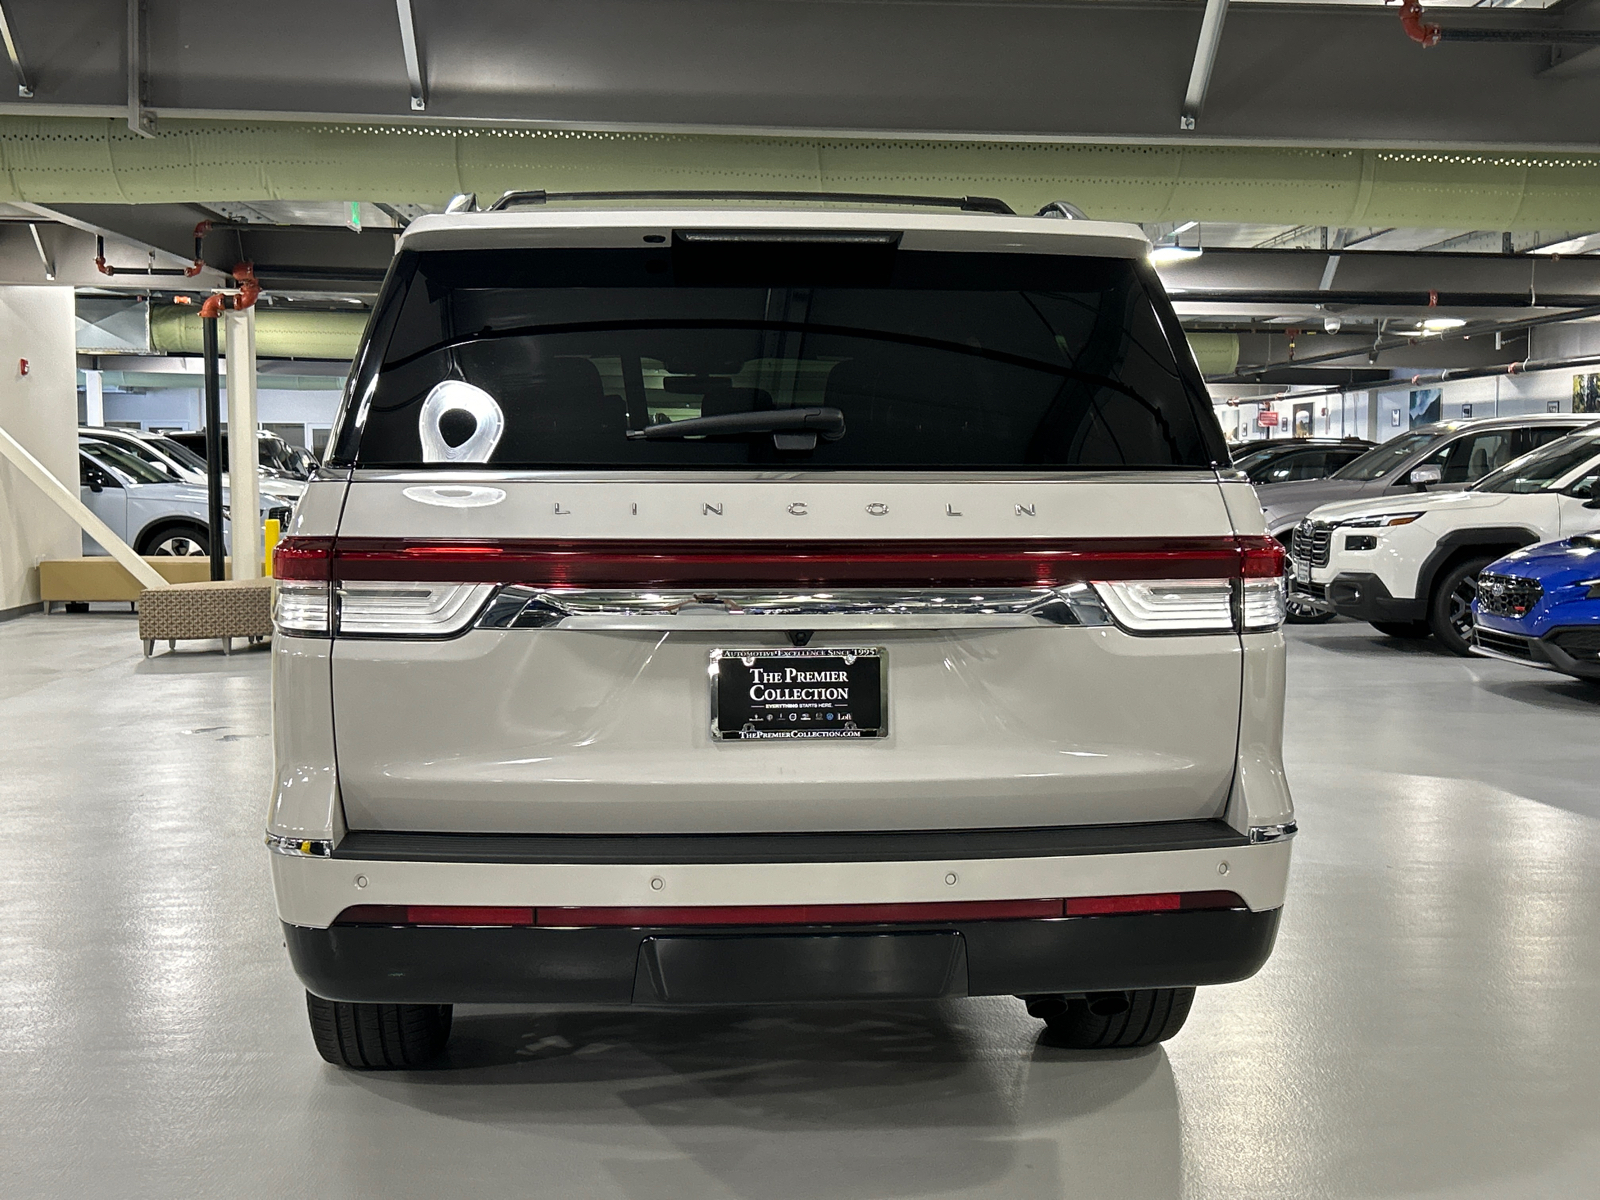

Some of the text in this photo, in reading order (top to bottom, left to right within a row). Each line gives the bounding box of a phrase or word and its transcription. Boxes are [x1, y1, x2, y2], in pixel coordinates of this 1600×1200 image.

[553, 501, 1037, 517] LINCOLN
[749, 667, 849, 684] THE PREMIER
[749, 684, 849, 701] COLLECTION
